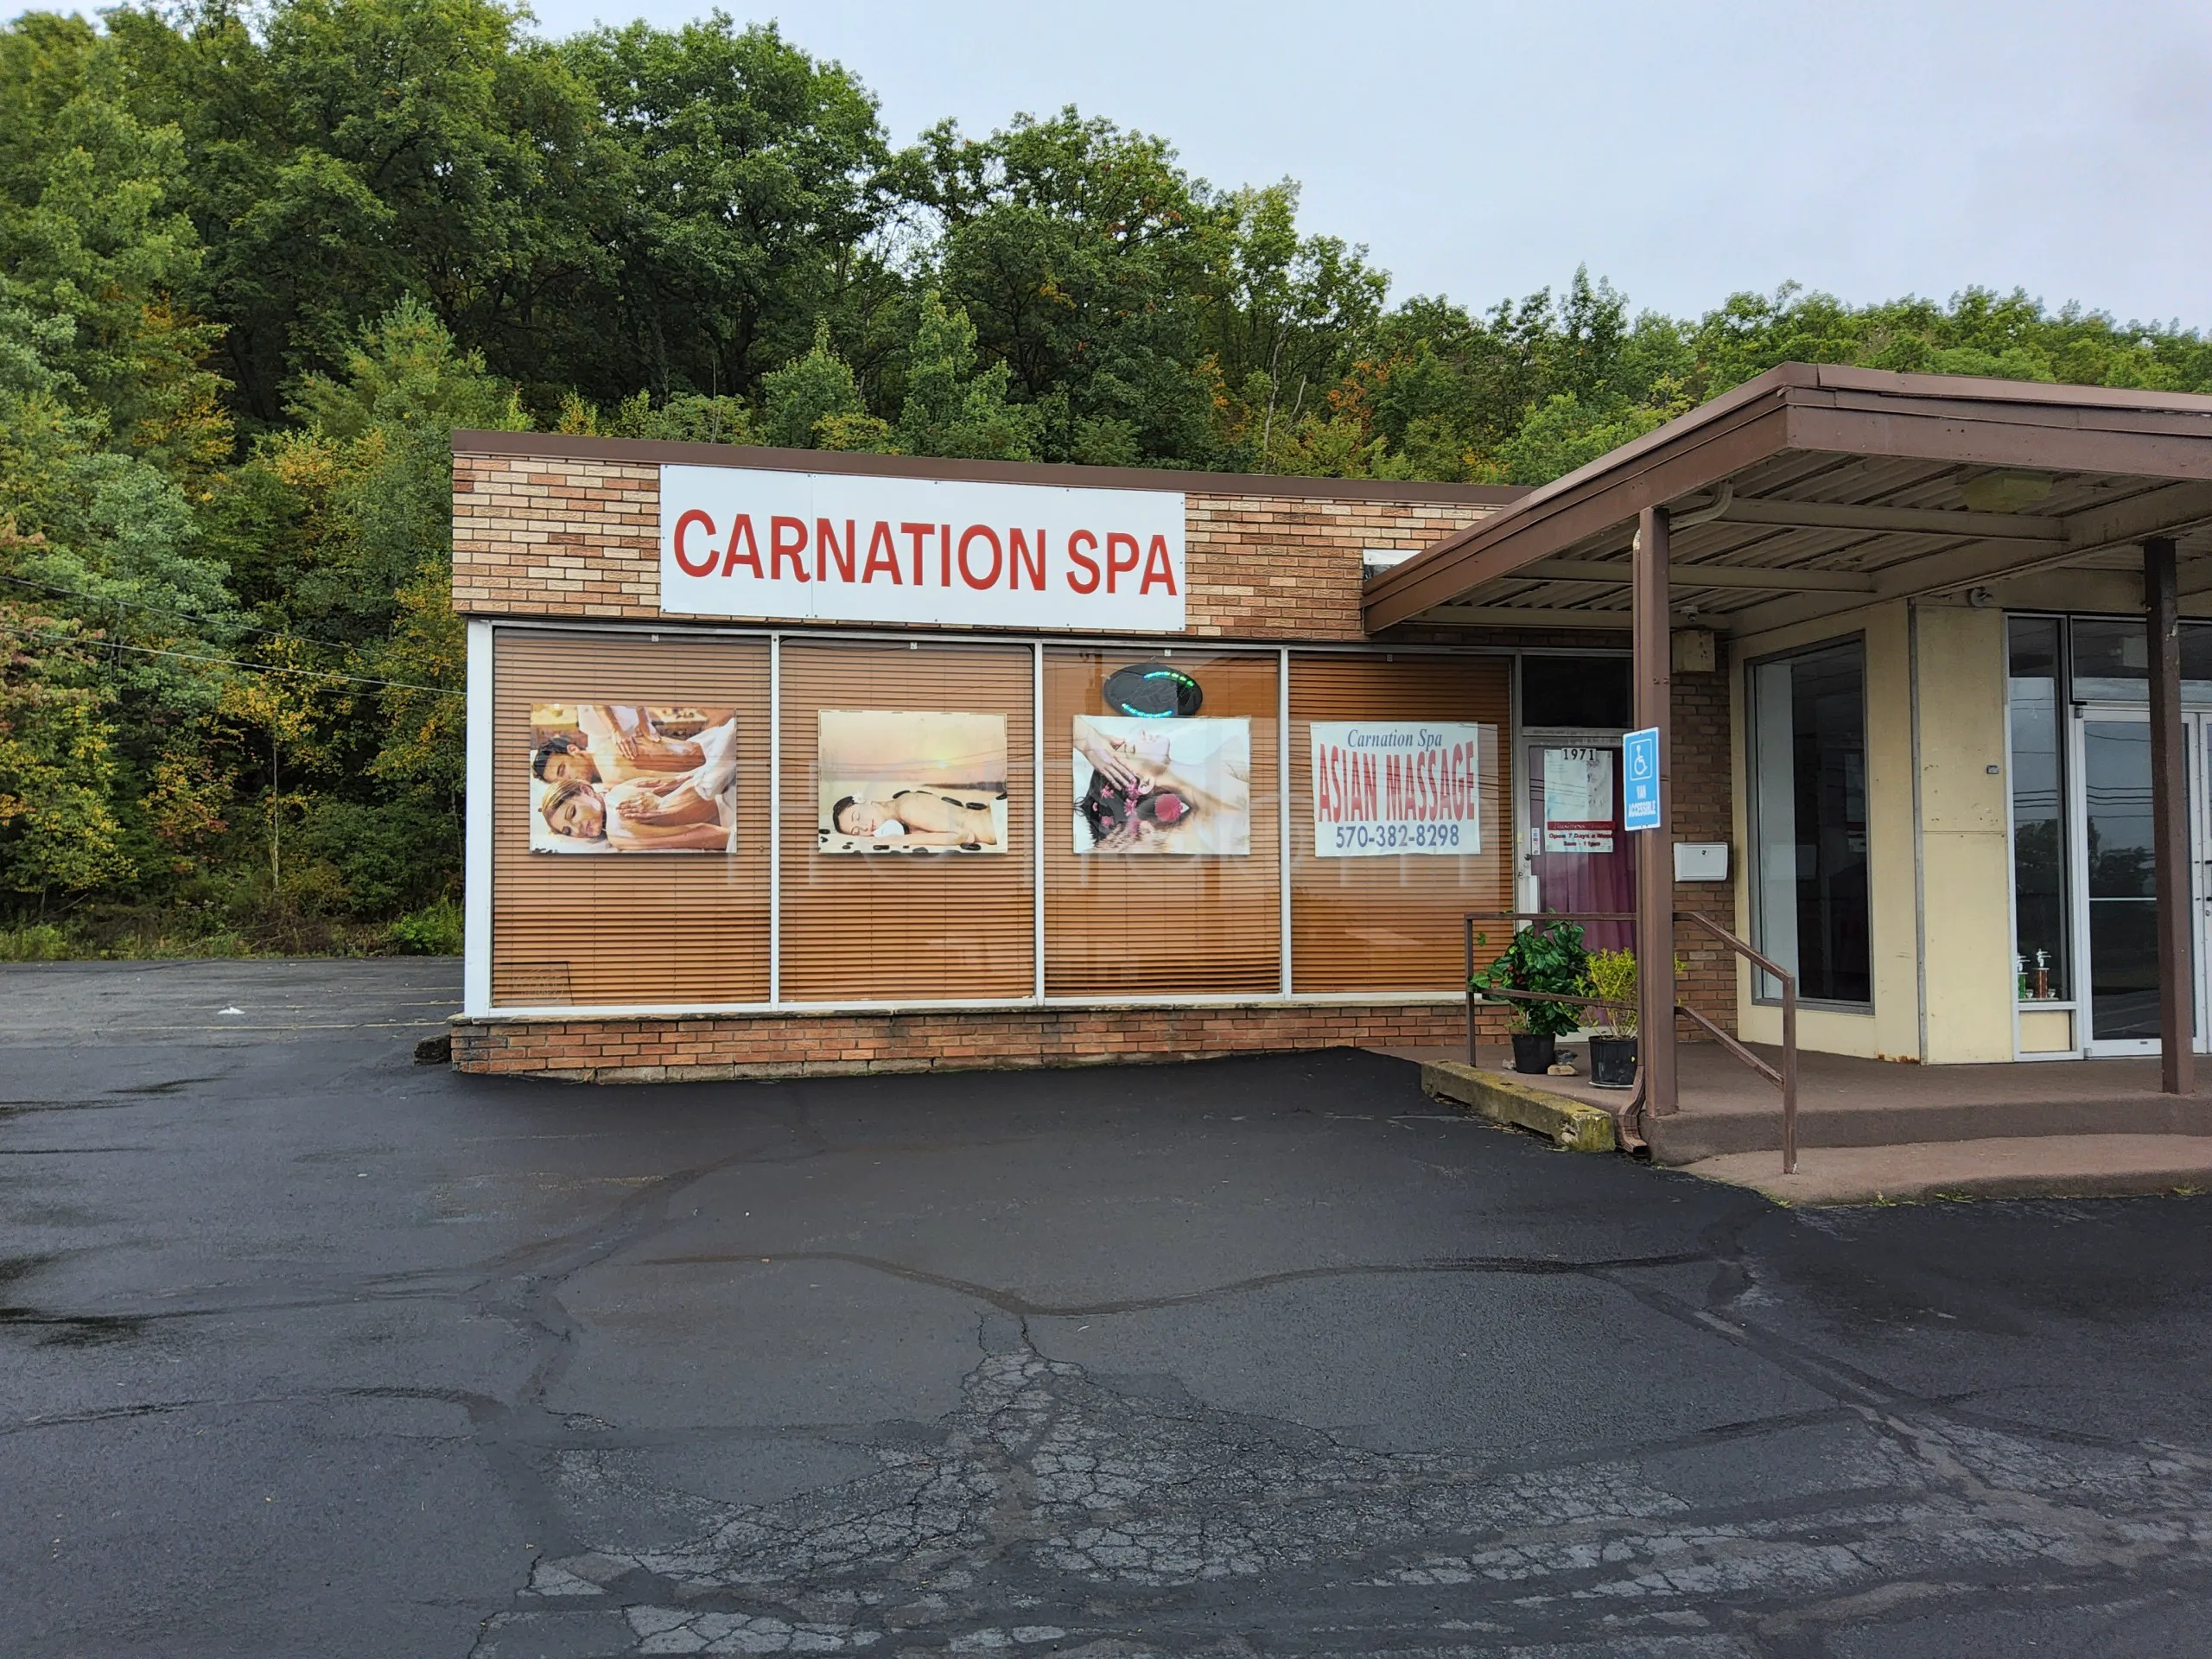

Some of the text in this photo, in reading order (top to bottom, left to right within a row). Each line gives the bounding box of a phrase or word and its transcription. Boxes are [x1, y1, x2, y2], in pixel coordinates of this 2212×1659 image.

[673, 508, 1178, 595] CARNATION SPA
[1347, 728, 1443, 752] Carnation Spa
[1563, 748, 1594, 761] 1971
[1319, 741, 1475, 823] ASIAN MASSAGE
[1628, 800, 1656, 817] ACCESSIBLE
[1336, 823, 1459, 849] 570-382-8298
